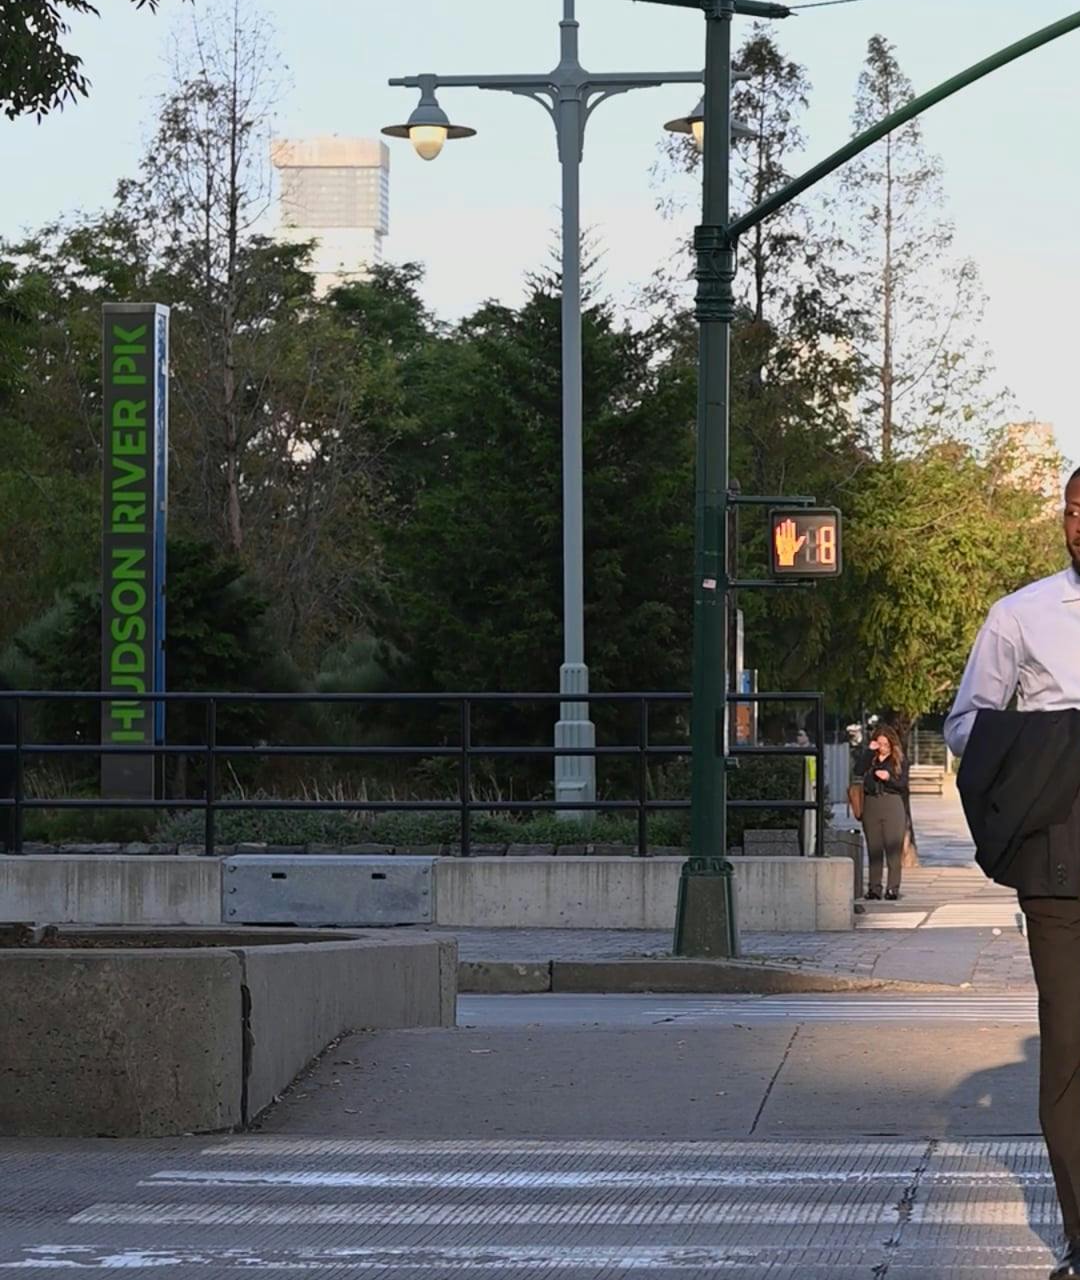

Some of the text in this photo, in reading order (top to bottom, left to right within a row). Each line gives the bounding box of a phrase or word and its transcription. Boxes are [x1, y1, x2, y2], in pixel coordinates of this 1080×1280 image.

[111, 325, 146, 742] HUDSON RIVER PK
